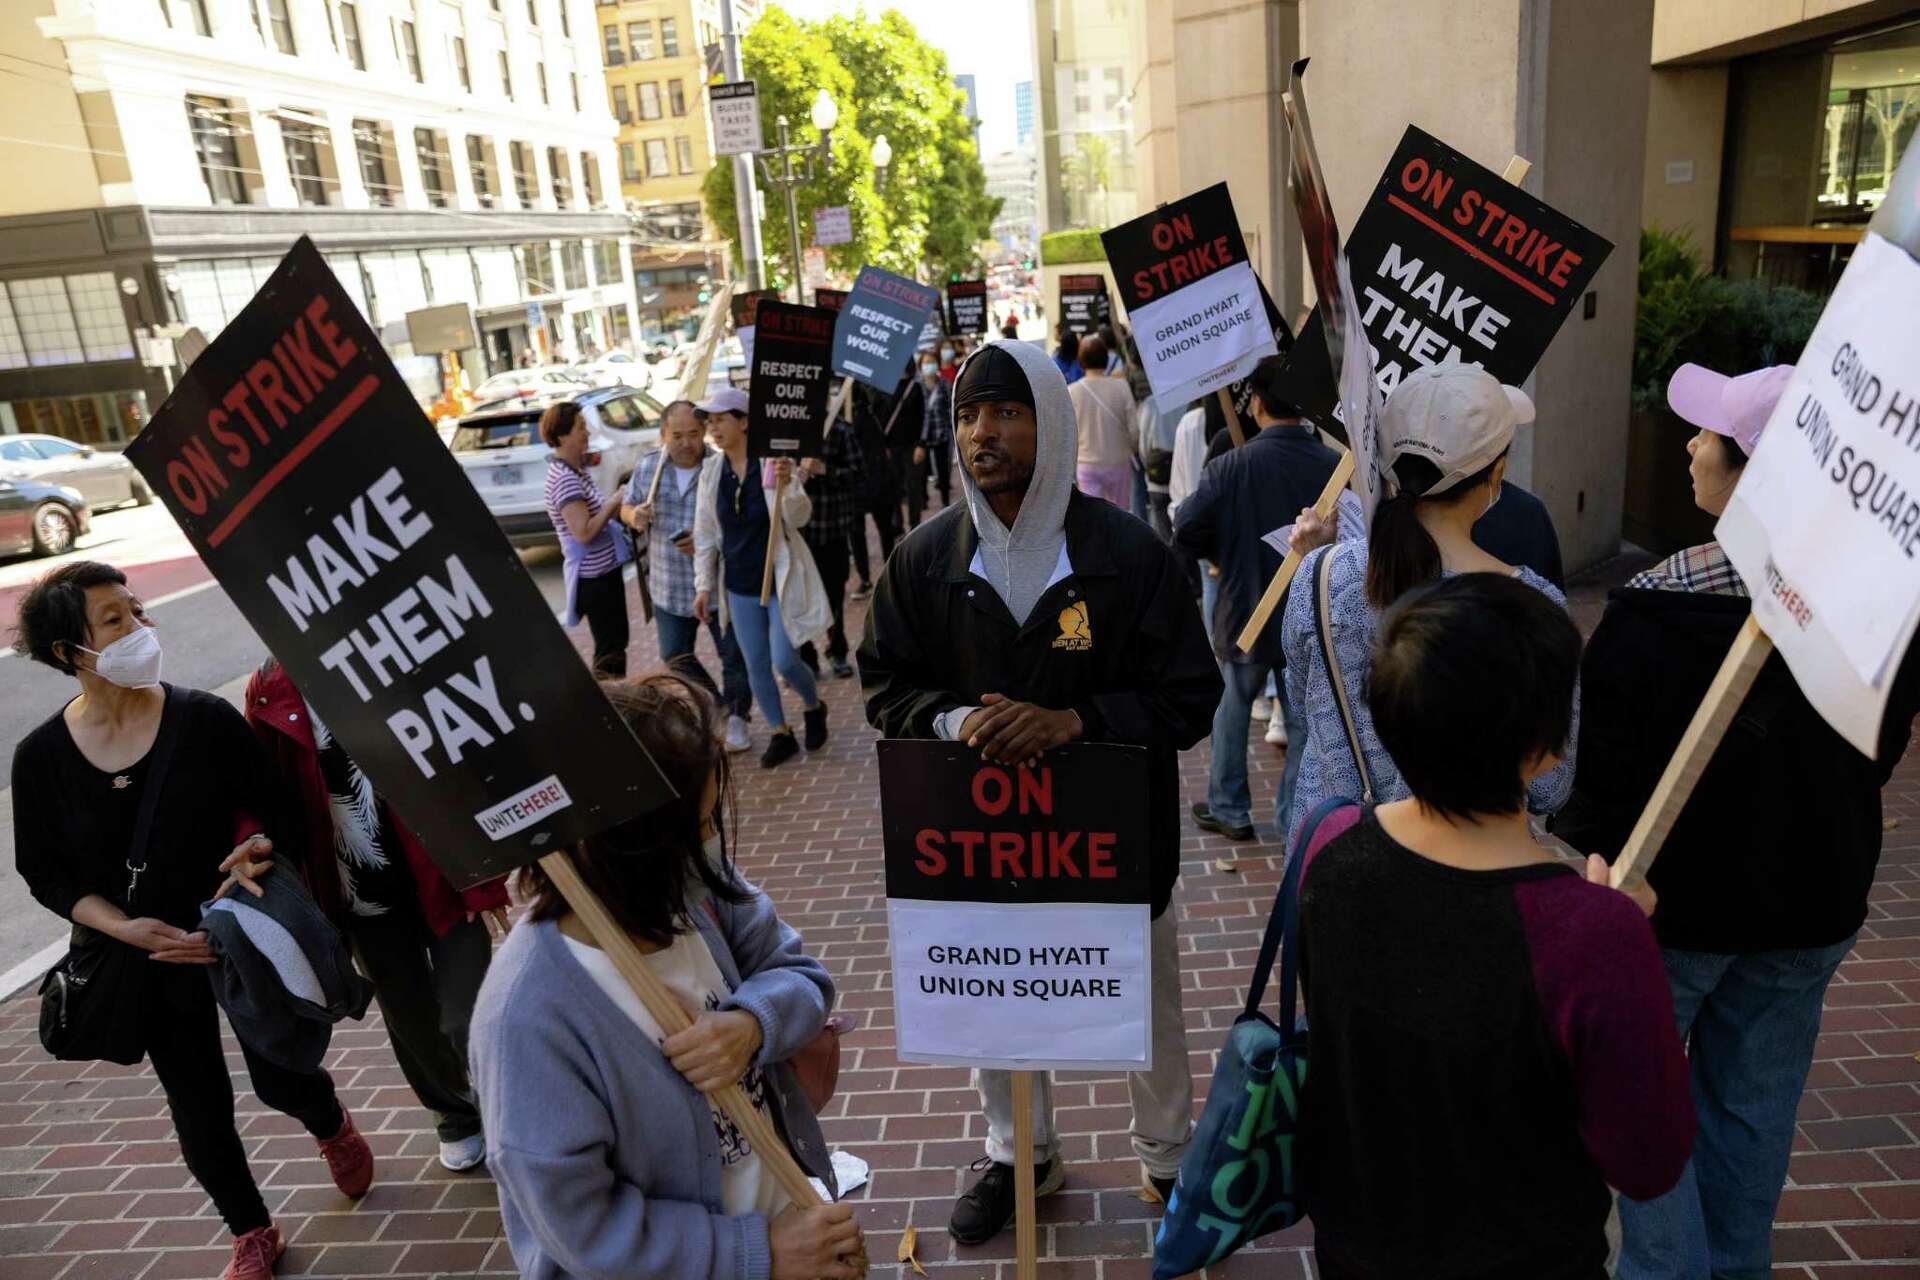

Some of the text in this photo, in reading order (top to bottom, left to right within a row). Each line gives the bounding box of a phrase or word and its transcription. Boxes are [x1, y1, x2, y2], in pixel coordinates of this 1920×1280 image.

[717, 102, 751, 112] BUSES
[720, 115, 751, 125] TAXIS
[723, 128, 750, 138] ONLY
[1152, 213, 1194, 250] ON
[1402, 158, 1582, 288] ON STRIKE
[1133, 235, 1233, 299] STRIKE
[1155, 293, 1242, 342] GRAND HYATT
[1377, 243, 1511, 349] MAKE
[850, 304, 913, 334] RESPECT
[860, 324, 890, 343] OUR
[1156, 335, 1201, 362] UNION
[1202, 308, 1253, 341] SQUARE
[847, 334, 890, 360] WORK.
[760, 361, 822, 380] RESPECT
[775, 384, 806, 399] OUR
[166, 294, 359, 517] ON STRIKE
[765, 404, 810, 420] WORK.
[267, 466, 433, 633] MAKE
[319, 553, 493, 704] THEM
[386, 655, 535, 780] PAY.
[483, 783, 564, 833] UNITEHERE!
[972, 766, 1054, 817] ON
[914, 829, 1118, 880] STRIKE
[927, 945, 1109, 966] GRAND HYATT
[920, 975, 1121, 1001] UNION SQUARE
